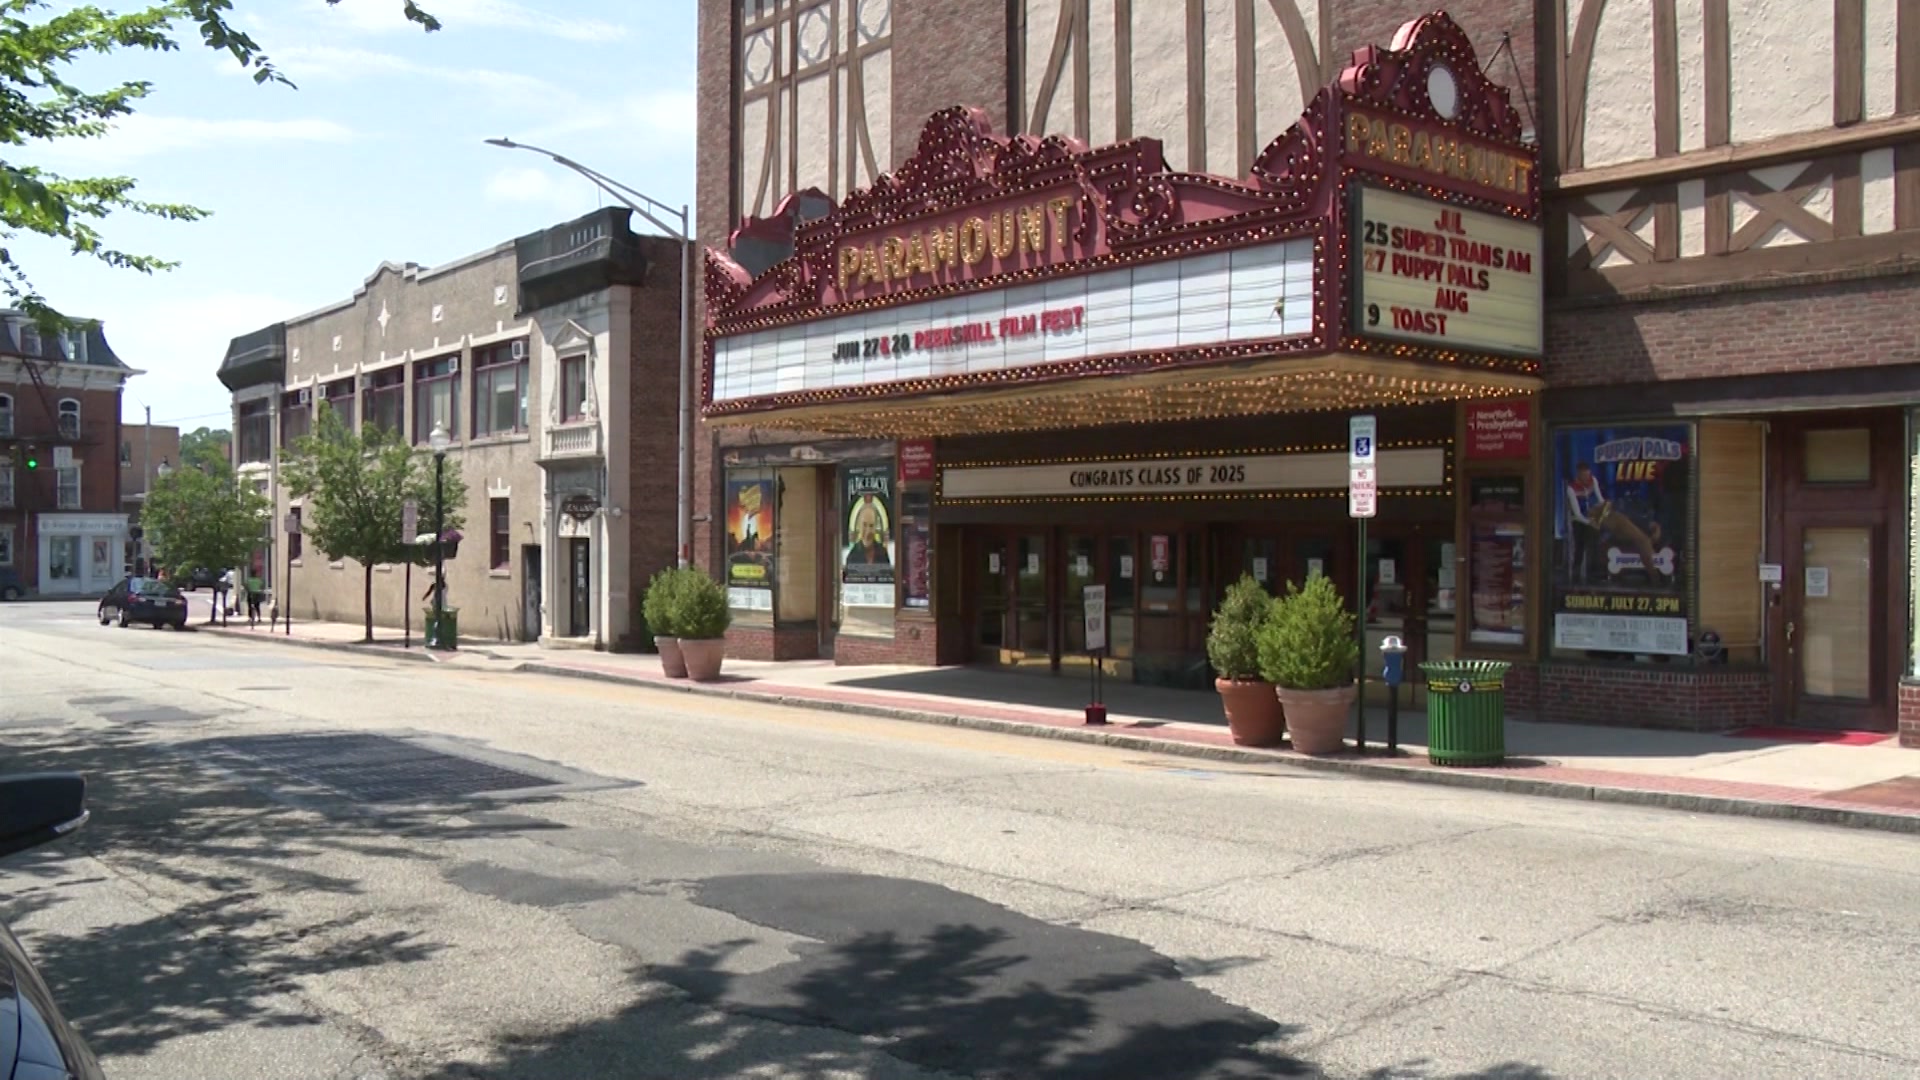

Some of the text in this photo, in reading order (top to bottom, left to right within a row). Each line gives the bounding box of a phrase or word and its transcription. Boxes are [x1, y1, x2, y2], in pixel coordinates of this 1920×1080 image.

[1346, 112, 1533, 195] PARAMOUNT
[1434, 208, 1466, 235] JUL
[839, 195, 1075, 288] PARAMOUNT
[1364, 220, 1531, 275] 25 SUPER TRANS AM
[1364, 247, 1489, 291] 27 PUPPY PALS
[1435, 286, 1468, 313] AUG
[832, 340, 860, 361] JUN
[914, 321, 995, 350] PEEKSKILL
[999, 314, 1037, 338] FILM
[1041, 306, 1084, 334] FEST
[1368, 303, 1447, 336] 9 TOAST
[1595, 437, 1682, 463] PUPPY PALS
[1070, 465, 1246, 488] CONGRATS CLASS OF 2025
[1616, 461, 1657, 481] LIVE
[1565, 595, 1680, 612] SUNDAY, JULY 27, 3PM
